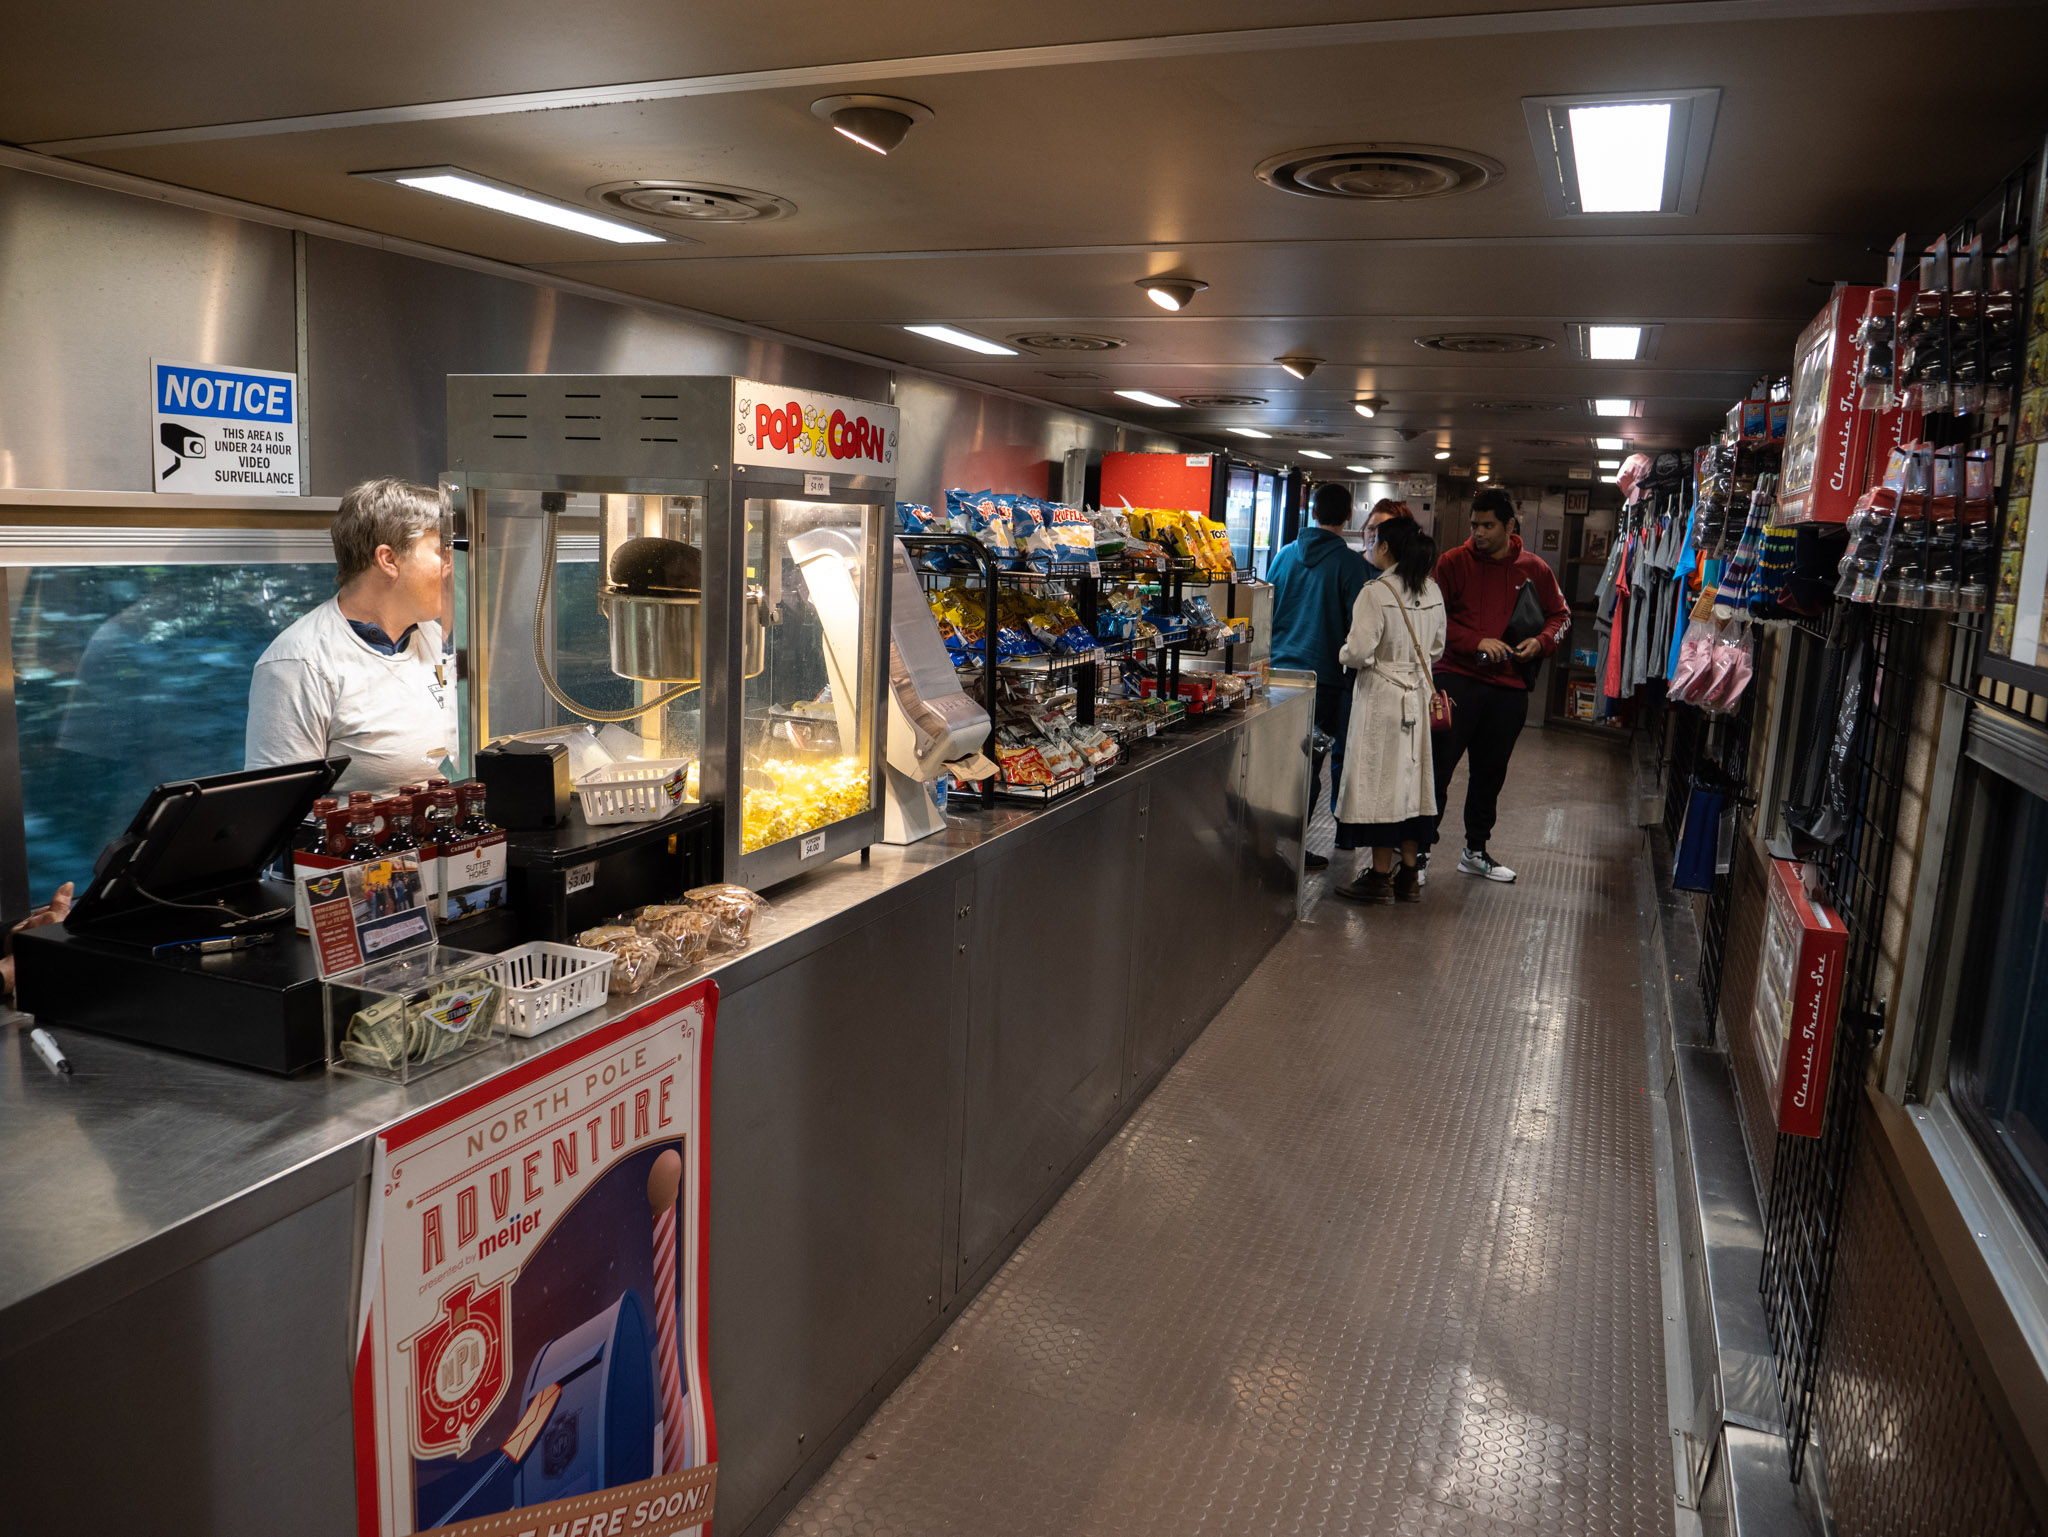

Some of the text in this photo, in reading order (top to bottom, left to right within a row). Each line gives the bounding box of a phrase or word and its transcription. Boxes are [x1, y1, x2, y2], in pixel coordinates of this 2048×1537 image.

[164, 374, 287, 416] NOTICE
[1840, 354, 1861, 412] Train
[214, 440, 292, 456] UNDER 24 HOUR
[223, 427, 284, 442] THIS AREA IS
[755, 401, 885, 463] POP CORN
[239, 456, 271, 469] VIDEO
[1830, 416, 1852, 491] Classic
[214, 469, 295, 485] SURVEILLANCE
[1568, 493, 1588, 510] EXIT
[450, 834, 504, 853] CABERNET SAUVIGNON
[465, 859, 491, 873] SUTTER
[469, 867, 489, 880] HOME
[568, 872, 592, 890] $3.00
[1793, 953, 1827, 1108] Classic Train Set
[467, 1047, 648, 1158] NORTH POLE
[421, 1074, 675, 1276] ADVENTURE
[418, 1208, 542, 1297] presented by meijer
[441, 1340, 481, 1392] NPA
[547, 1483, 711, 1537] HERE SOON!
